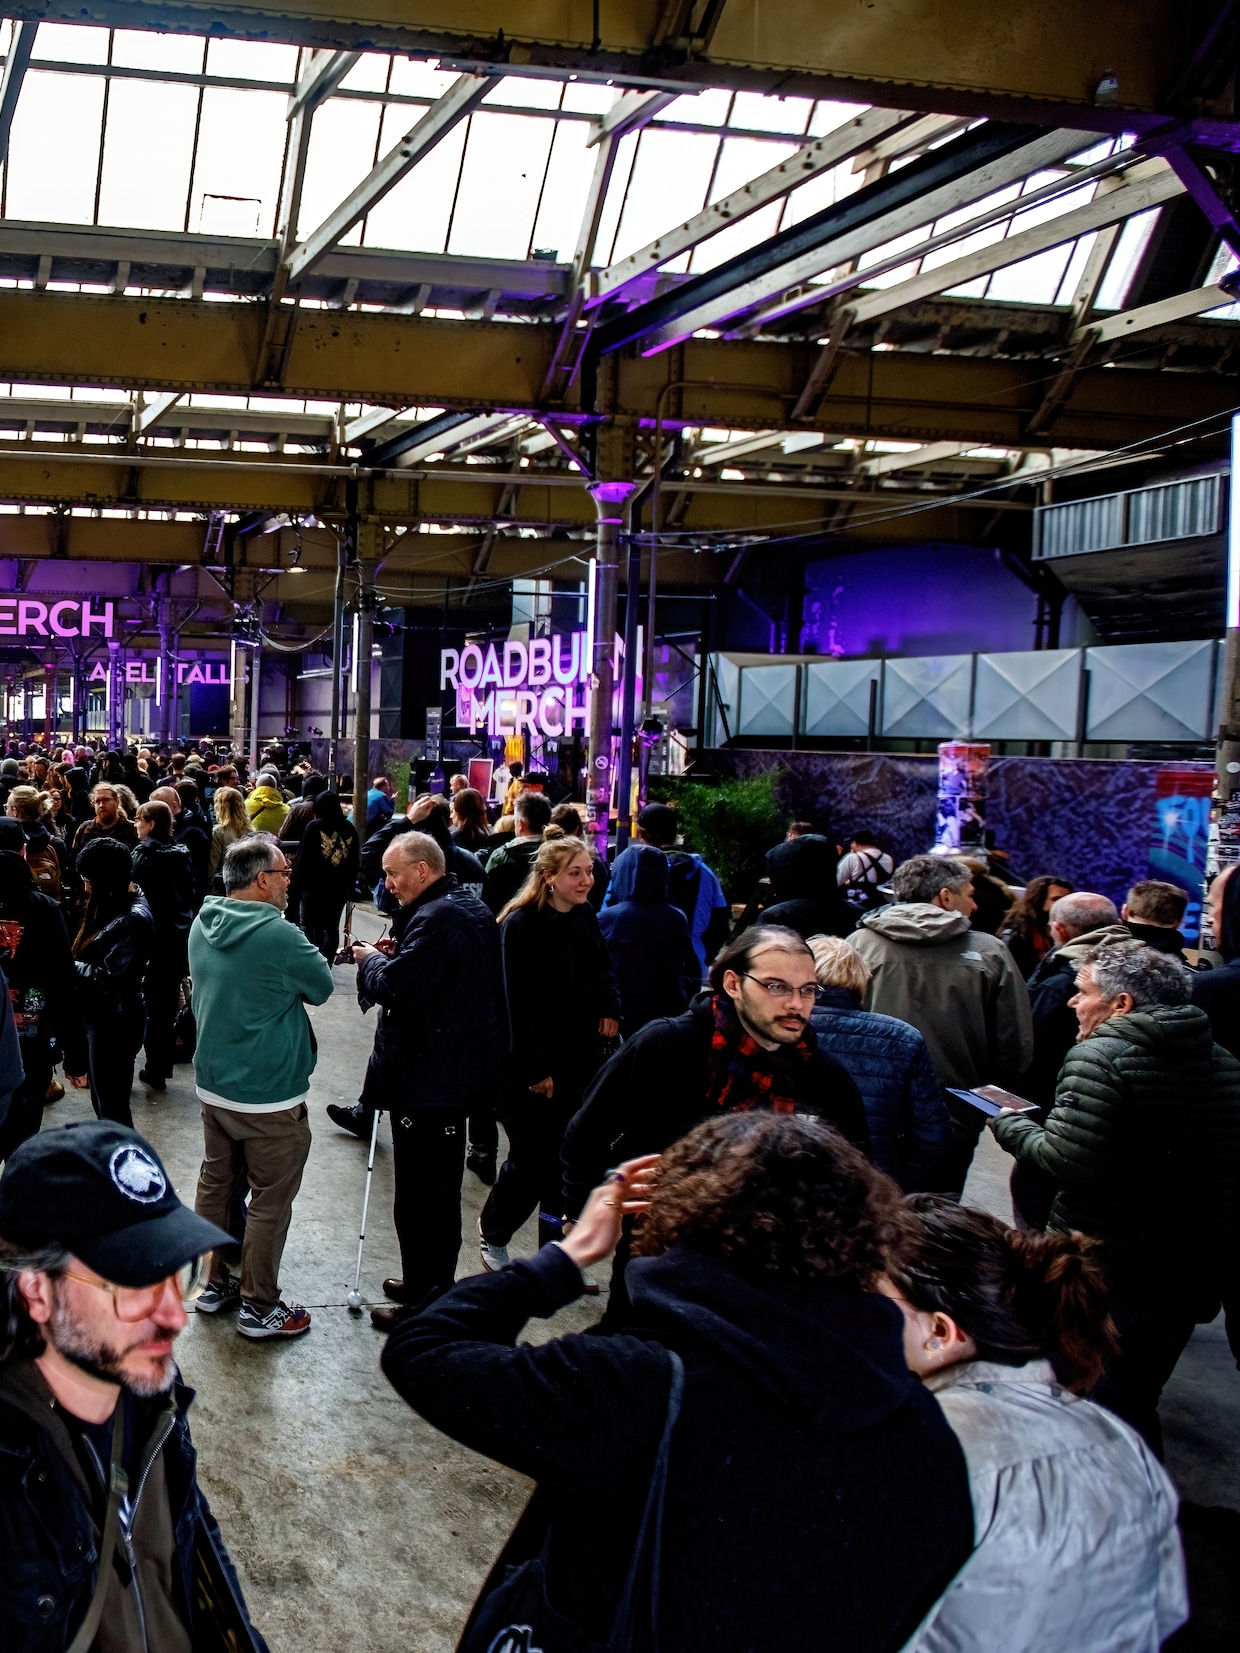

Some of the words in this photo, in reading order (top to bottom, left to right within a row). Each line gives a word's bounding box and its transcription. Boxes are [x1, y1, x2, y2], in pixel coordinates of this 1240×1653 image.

[85, 661, 157, 683] AEL
[166, 662, 250, 685] TALL
[440, 630, 626, 691] ROADBUN
[469, 686, 593, 738] MERCH
